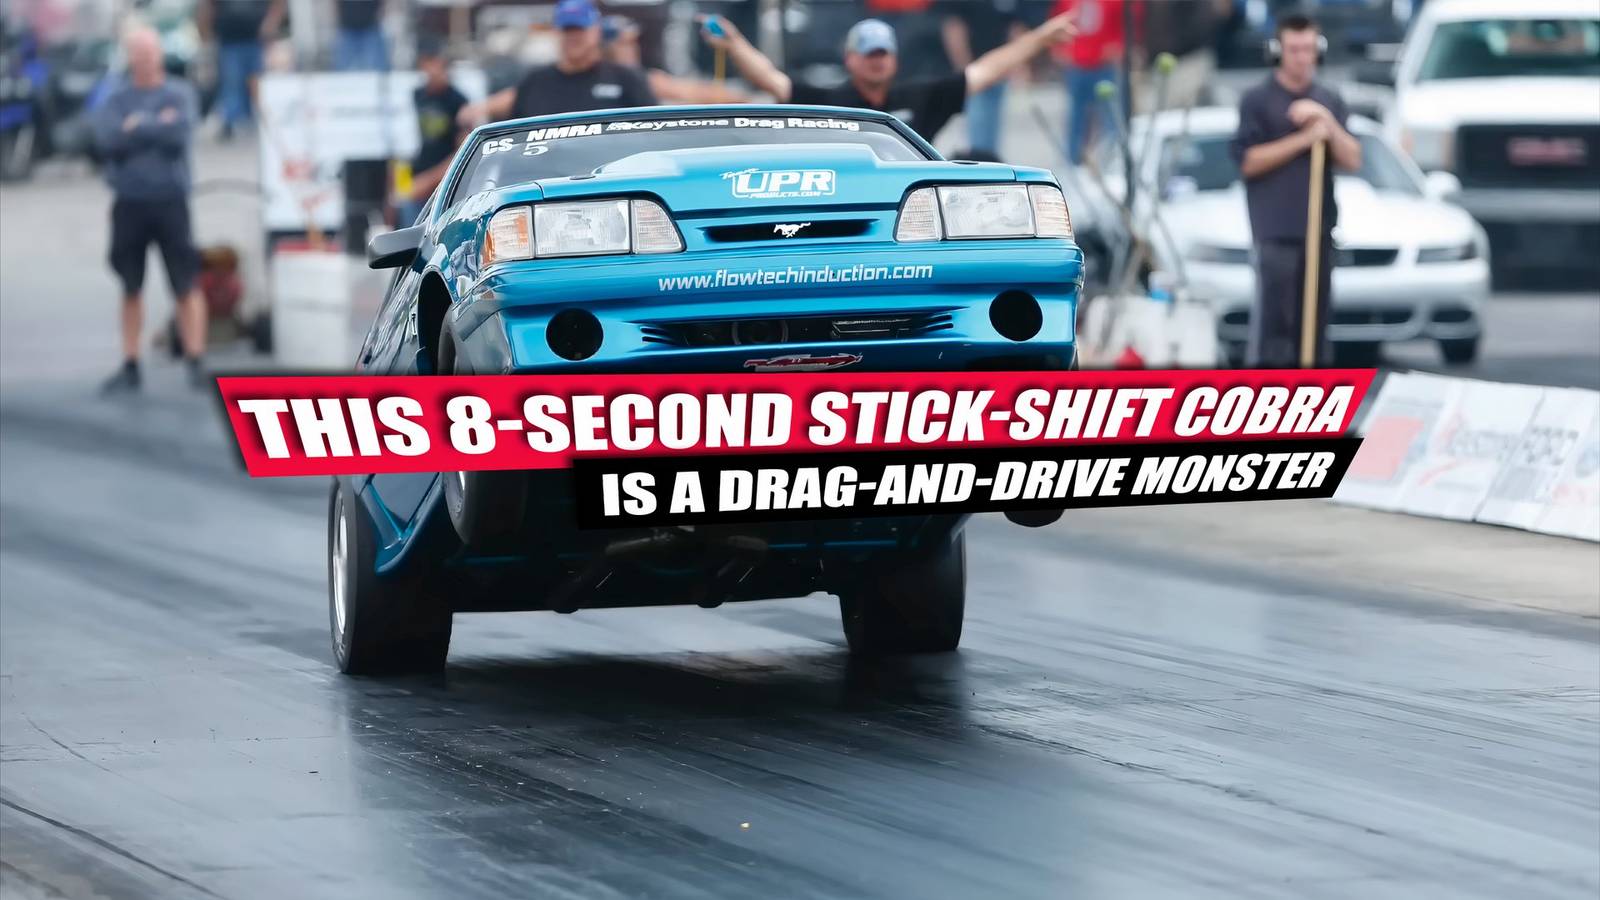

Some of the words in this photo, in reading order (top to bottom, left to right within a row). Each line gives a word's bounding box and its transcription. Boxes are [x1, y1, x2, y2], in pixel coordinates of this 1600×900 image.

[526, 123, 602, 142] NMRA
[626, 118, 729, 131] Keystone
[734, 117, 785, 129] Drag
[787, 117, 860, 132] Racing
[482, 137, 514, 156] CS
[523, 142, 549, 156] 5
[736, 171, 832, 193] UPR
[658, 264, 933, 292] www.flowtechinduction.com
